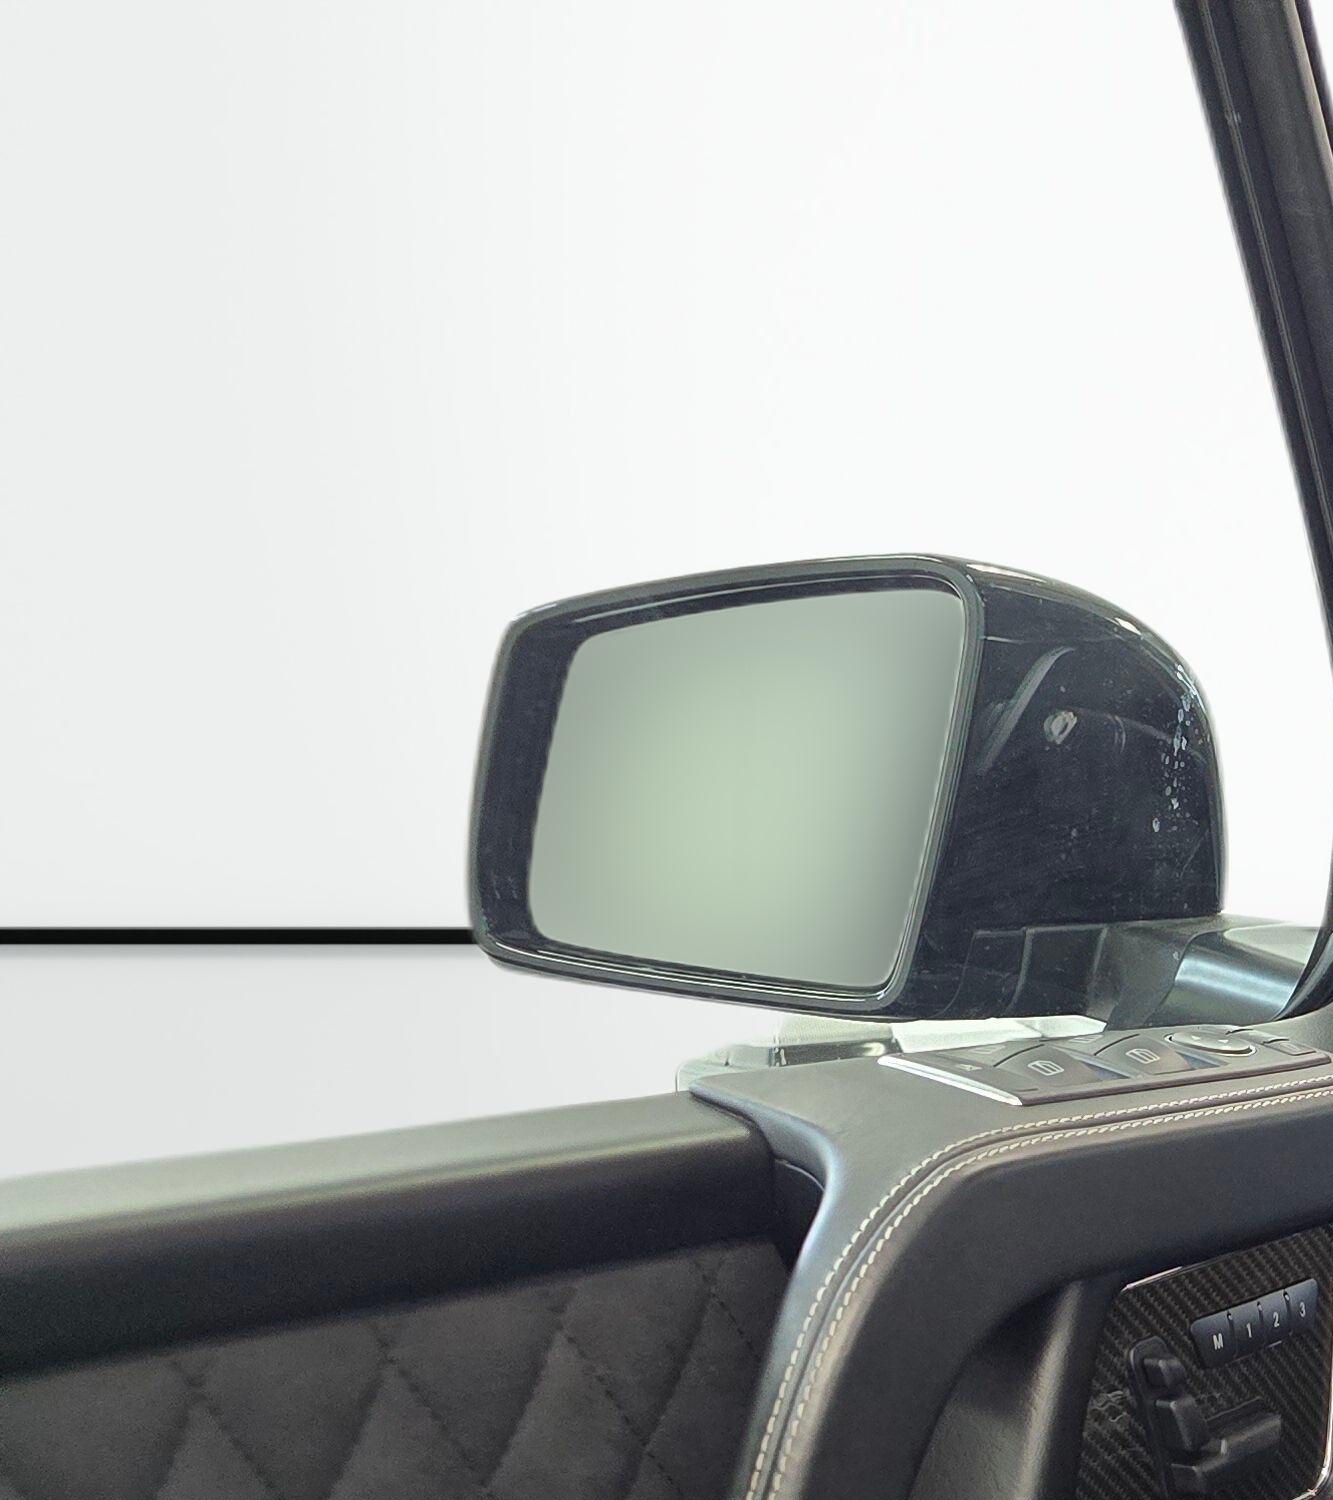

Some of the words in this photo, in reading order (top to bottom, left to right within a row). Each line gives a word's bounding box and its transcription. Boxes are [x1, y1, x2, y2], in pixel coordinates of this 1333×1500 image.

[1212, 1332, 1224, 1351] M
[1246, 1322, 1252, 1338] 1
[1272, 1311, 1280, 1328] 2
[1299, 1301, 1306, 1318] 3
